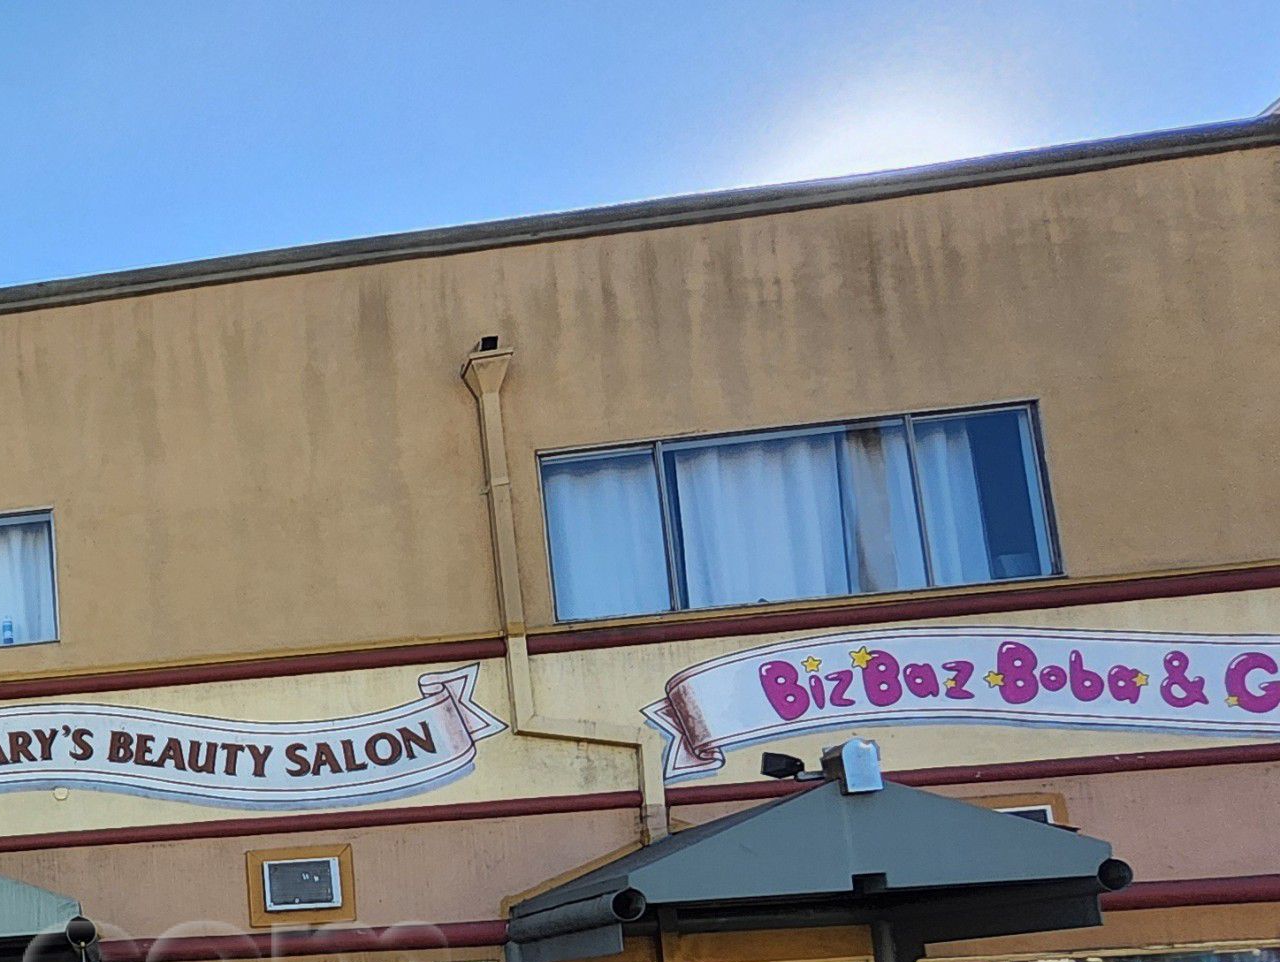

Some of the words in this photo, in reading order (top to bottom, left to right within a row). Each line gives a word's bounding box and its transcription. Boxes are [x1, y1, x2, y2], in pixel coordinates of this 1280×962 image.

[997, 641, 1142, 704] Boba
[1160, 650, 1210, 707] &
[106, 730, 274, 777] BEAUTY
[285, 720, 438, 777] SALON
